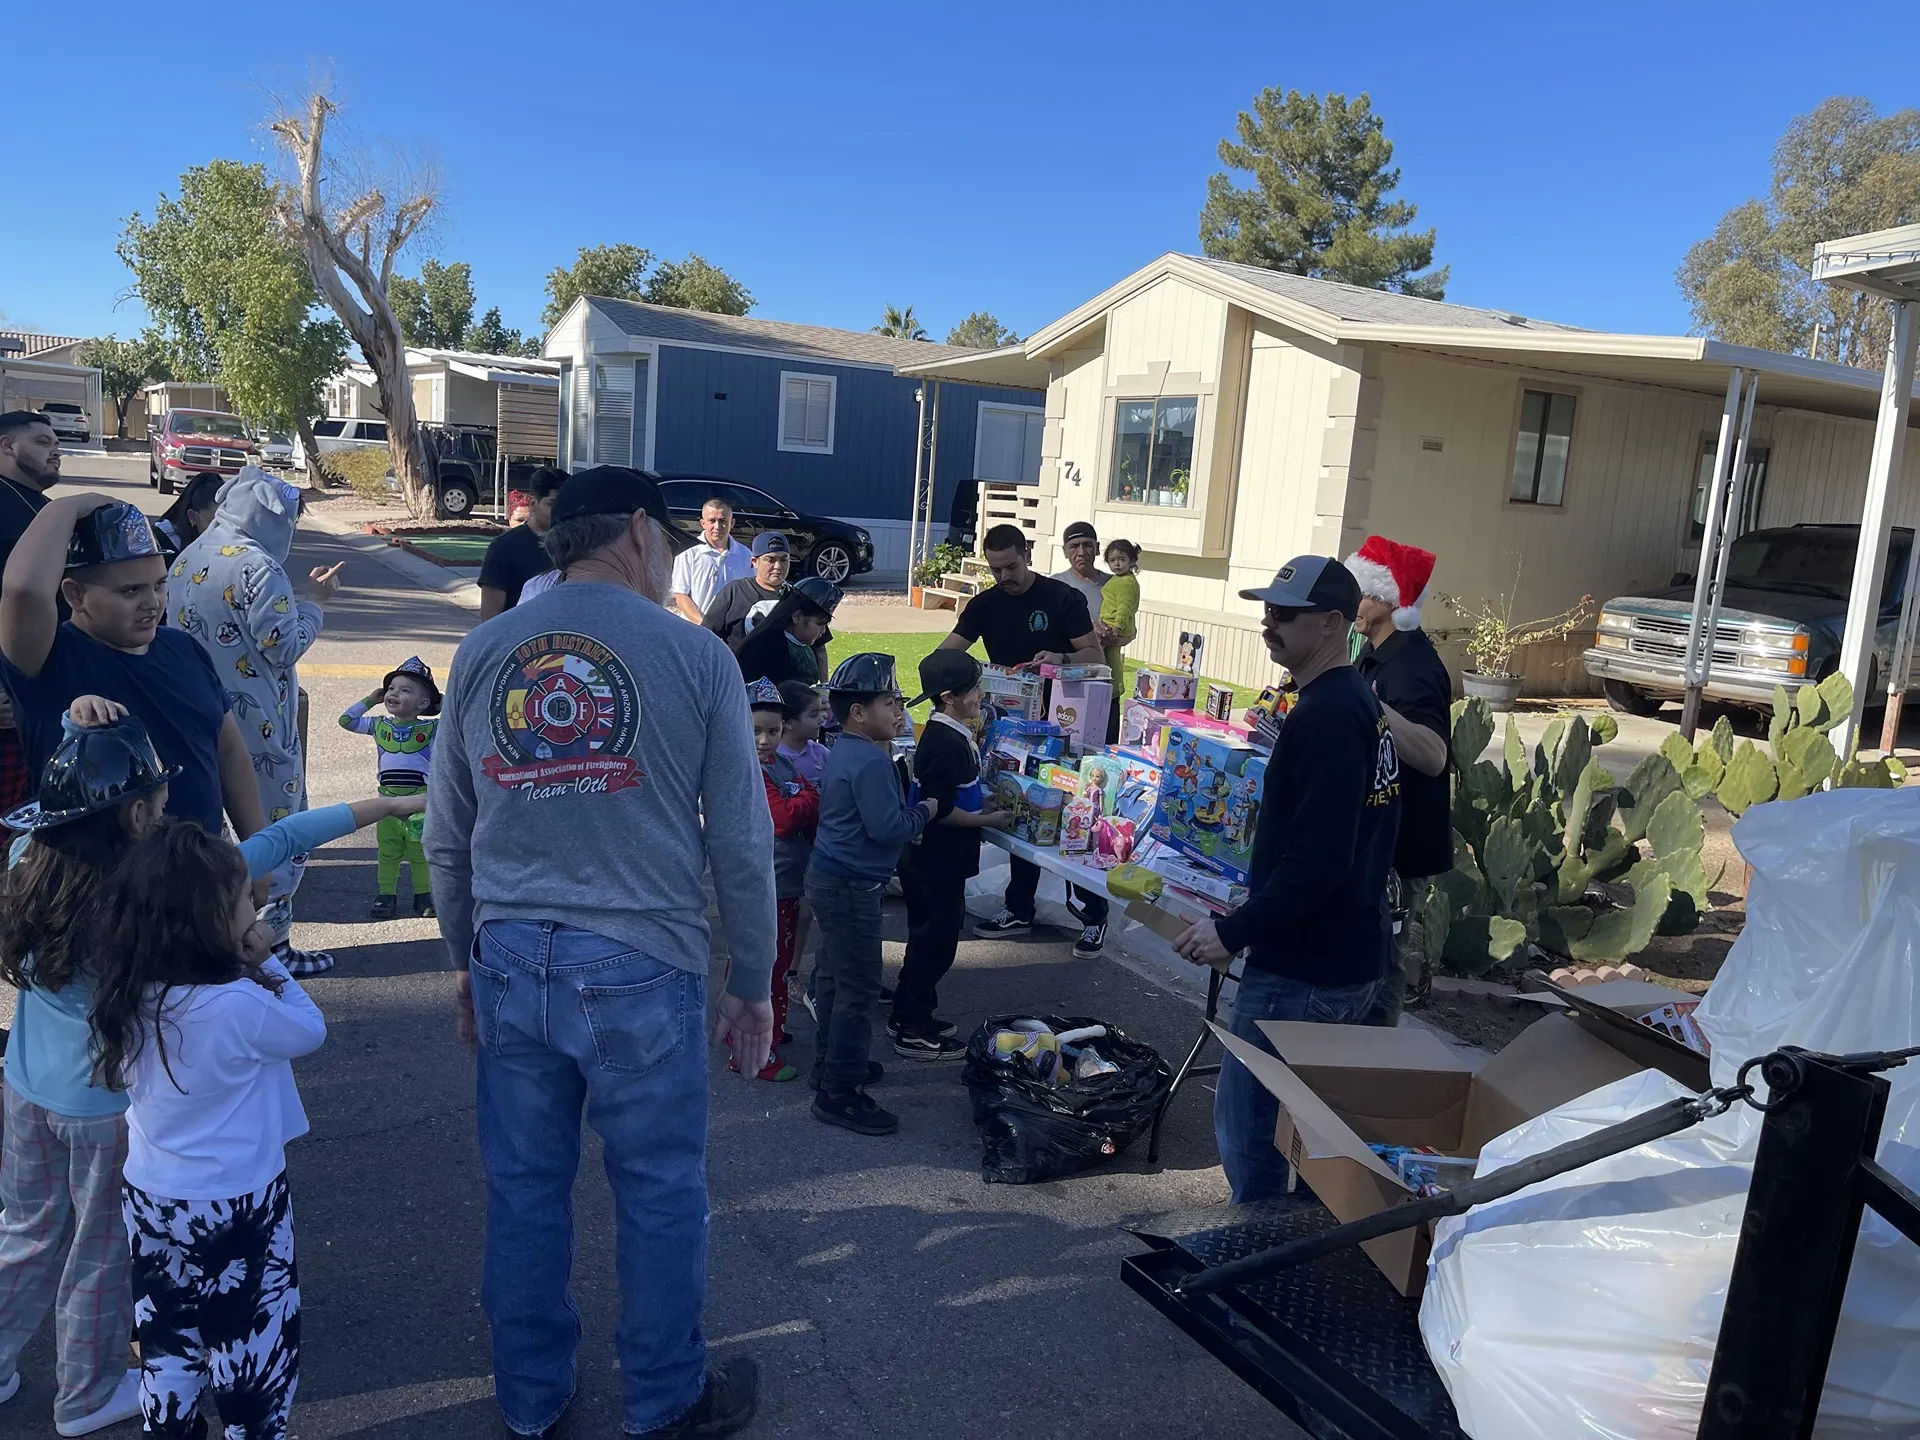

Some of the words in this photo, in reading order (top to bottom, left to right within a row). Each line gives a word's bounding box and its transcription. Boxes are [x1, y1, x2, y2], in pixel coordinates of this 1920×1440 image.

[1065, 461, 1082, 486] 74
[515, 635, 549, 663] 10TH
[552, 634, 614, 667] DISTRICT
[495, 662, 517, 707] CALIFORNIA
[553, 678, 567, 690] A
[607, 663, 625, 686] GUAM
[620, 688, 632, 723] ARIZONA
[495, 716, 508, 745] MEXICO
[612, 726, 629, 753] HAWAII
[506, 745, 520, 760] NEW
[498, 769, 539, 782] International
[540, 762, 577, 778] Association
[577, 762, 584, 771] of
